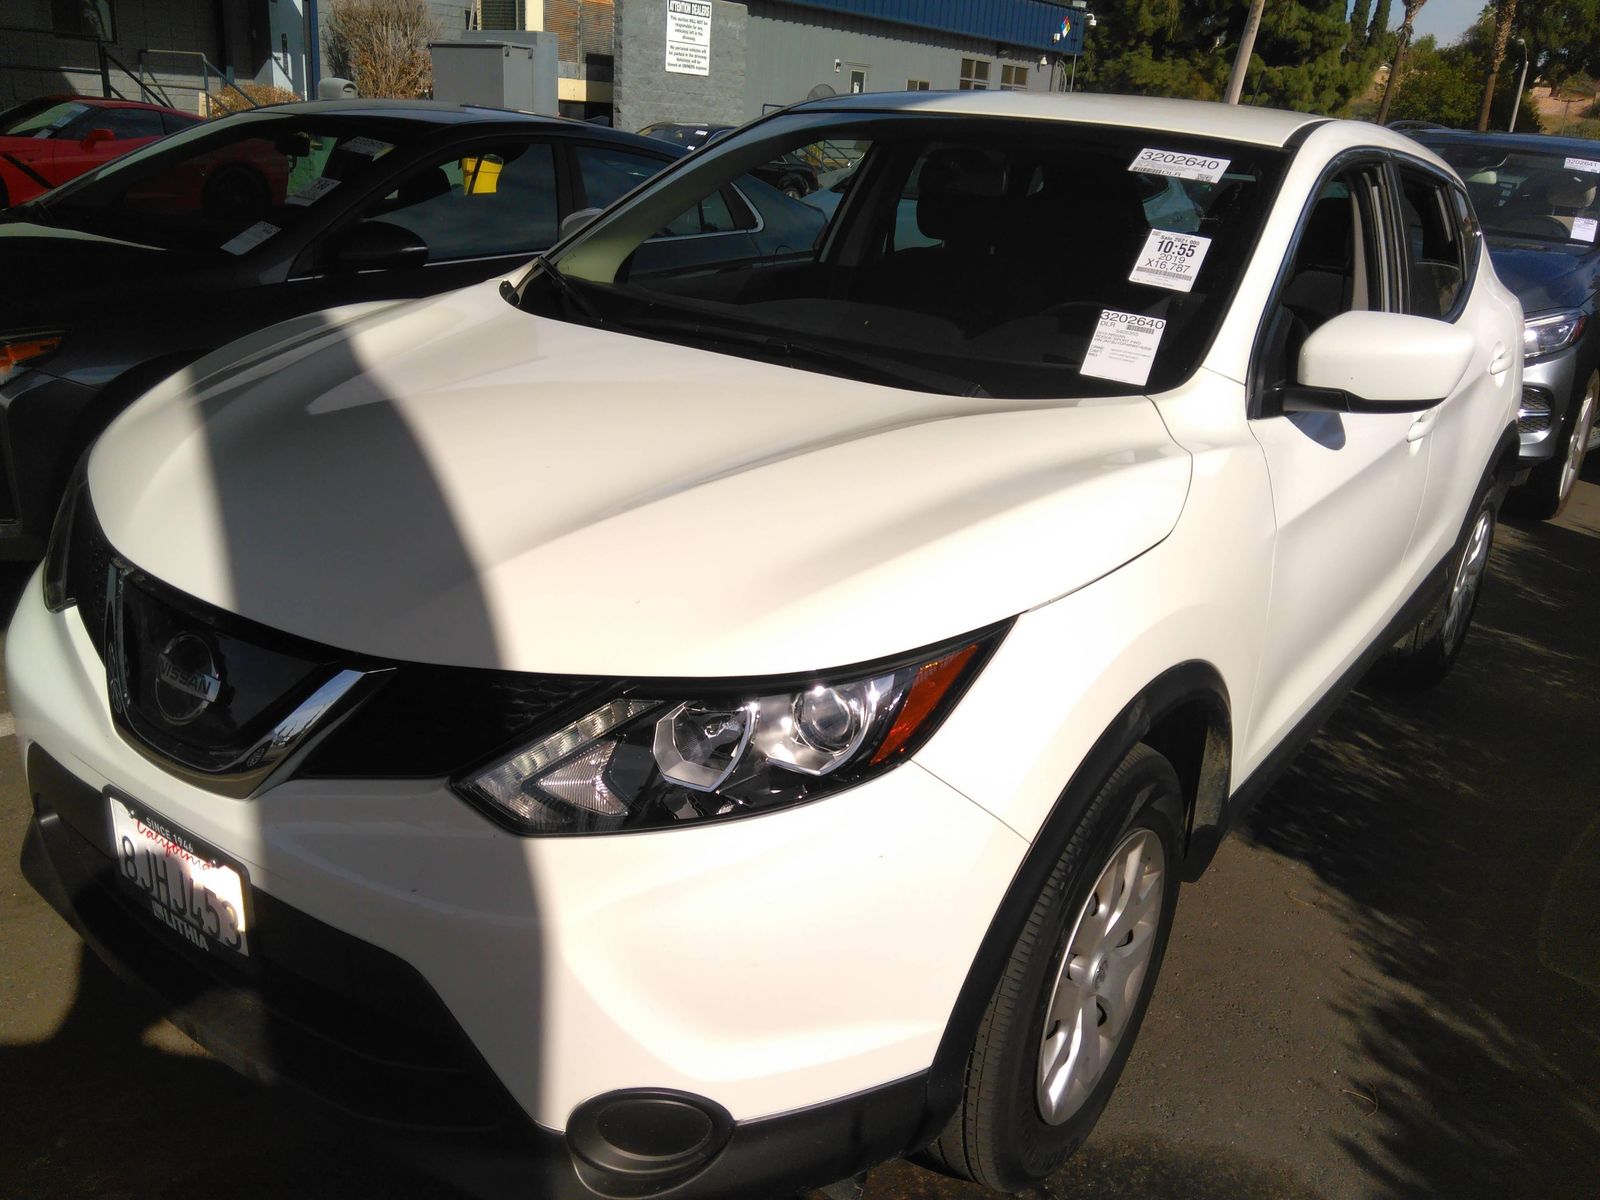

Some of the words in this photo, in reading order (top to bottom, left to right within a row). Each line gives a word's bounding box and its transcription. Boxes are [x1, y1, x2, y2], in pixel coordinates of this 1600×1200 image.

[670, 1, 691, 14] ATTENTION
[691, 4, 710, 17] DEALERS
[1141, 151, 1219, 170] 3202640
[1157, 240, 1197, 257] 10:55
[1145, 258, 1190, 273] X16,787
[1158, 253, 1186, 264] 2019
[1101, 311, 1165, 329] 3202640
[160, 659, 212, 695] NISSAN
[146, 817, 170, 836] SINCE
[172, 834, 194, 853] 1946
[163, 907, 209, 952] LITHIA
